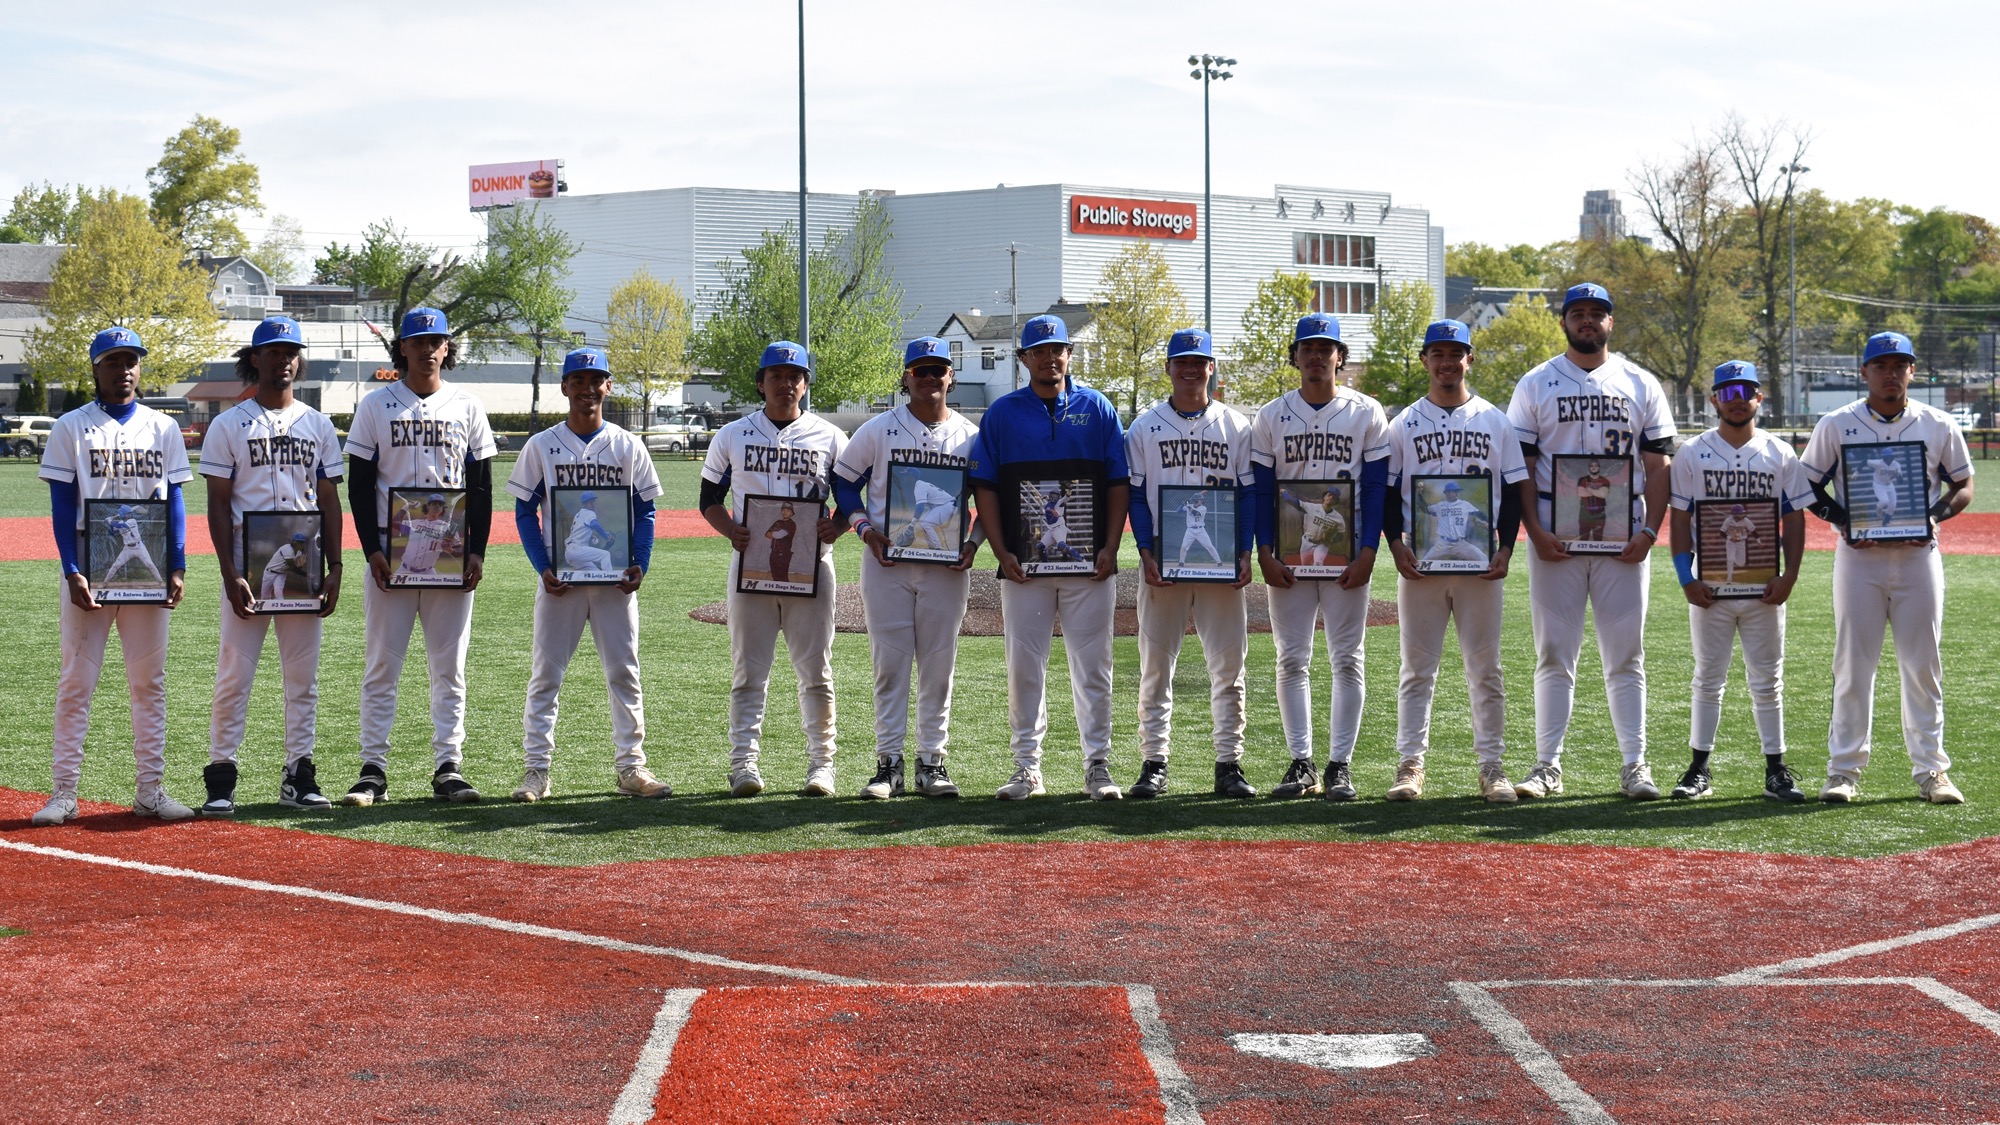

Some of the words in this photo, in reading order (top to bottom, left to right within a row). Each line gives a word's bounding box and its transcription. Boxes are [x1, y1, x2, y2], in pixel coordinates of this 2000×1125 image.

[472, 175, 525, 193] DUNKIN'
[1079, 204, 1129, 225] Public
[1132, 208, 1193, 234] Storage
[1557, 395, 1630, 423] EXPRESS
[391, 419, 461, 450] EXPRESS
[1284, 433, 1353, 464] EXPRESS
[1413, 430, 1491, 465] EXPRESS
[1604, 428, 1634, 455] 37
[89, 448, 163, 479] EXPRESS
[247, 437, 316, 468] EXPRESS
[744, 444, 819, 477] EXPRESS
[1158, 439, 1229, 470] EXPRESS
[555, 464, 623, 486] EXPRESS
[1703, 469, 1775, 499] EXPRESS
[1455, 517, 1464, 526] 22
